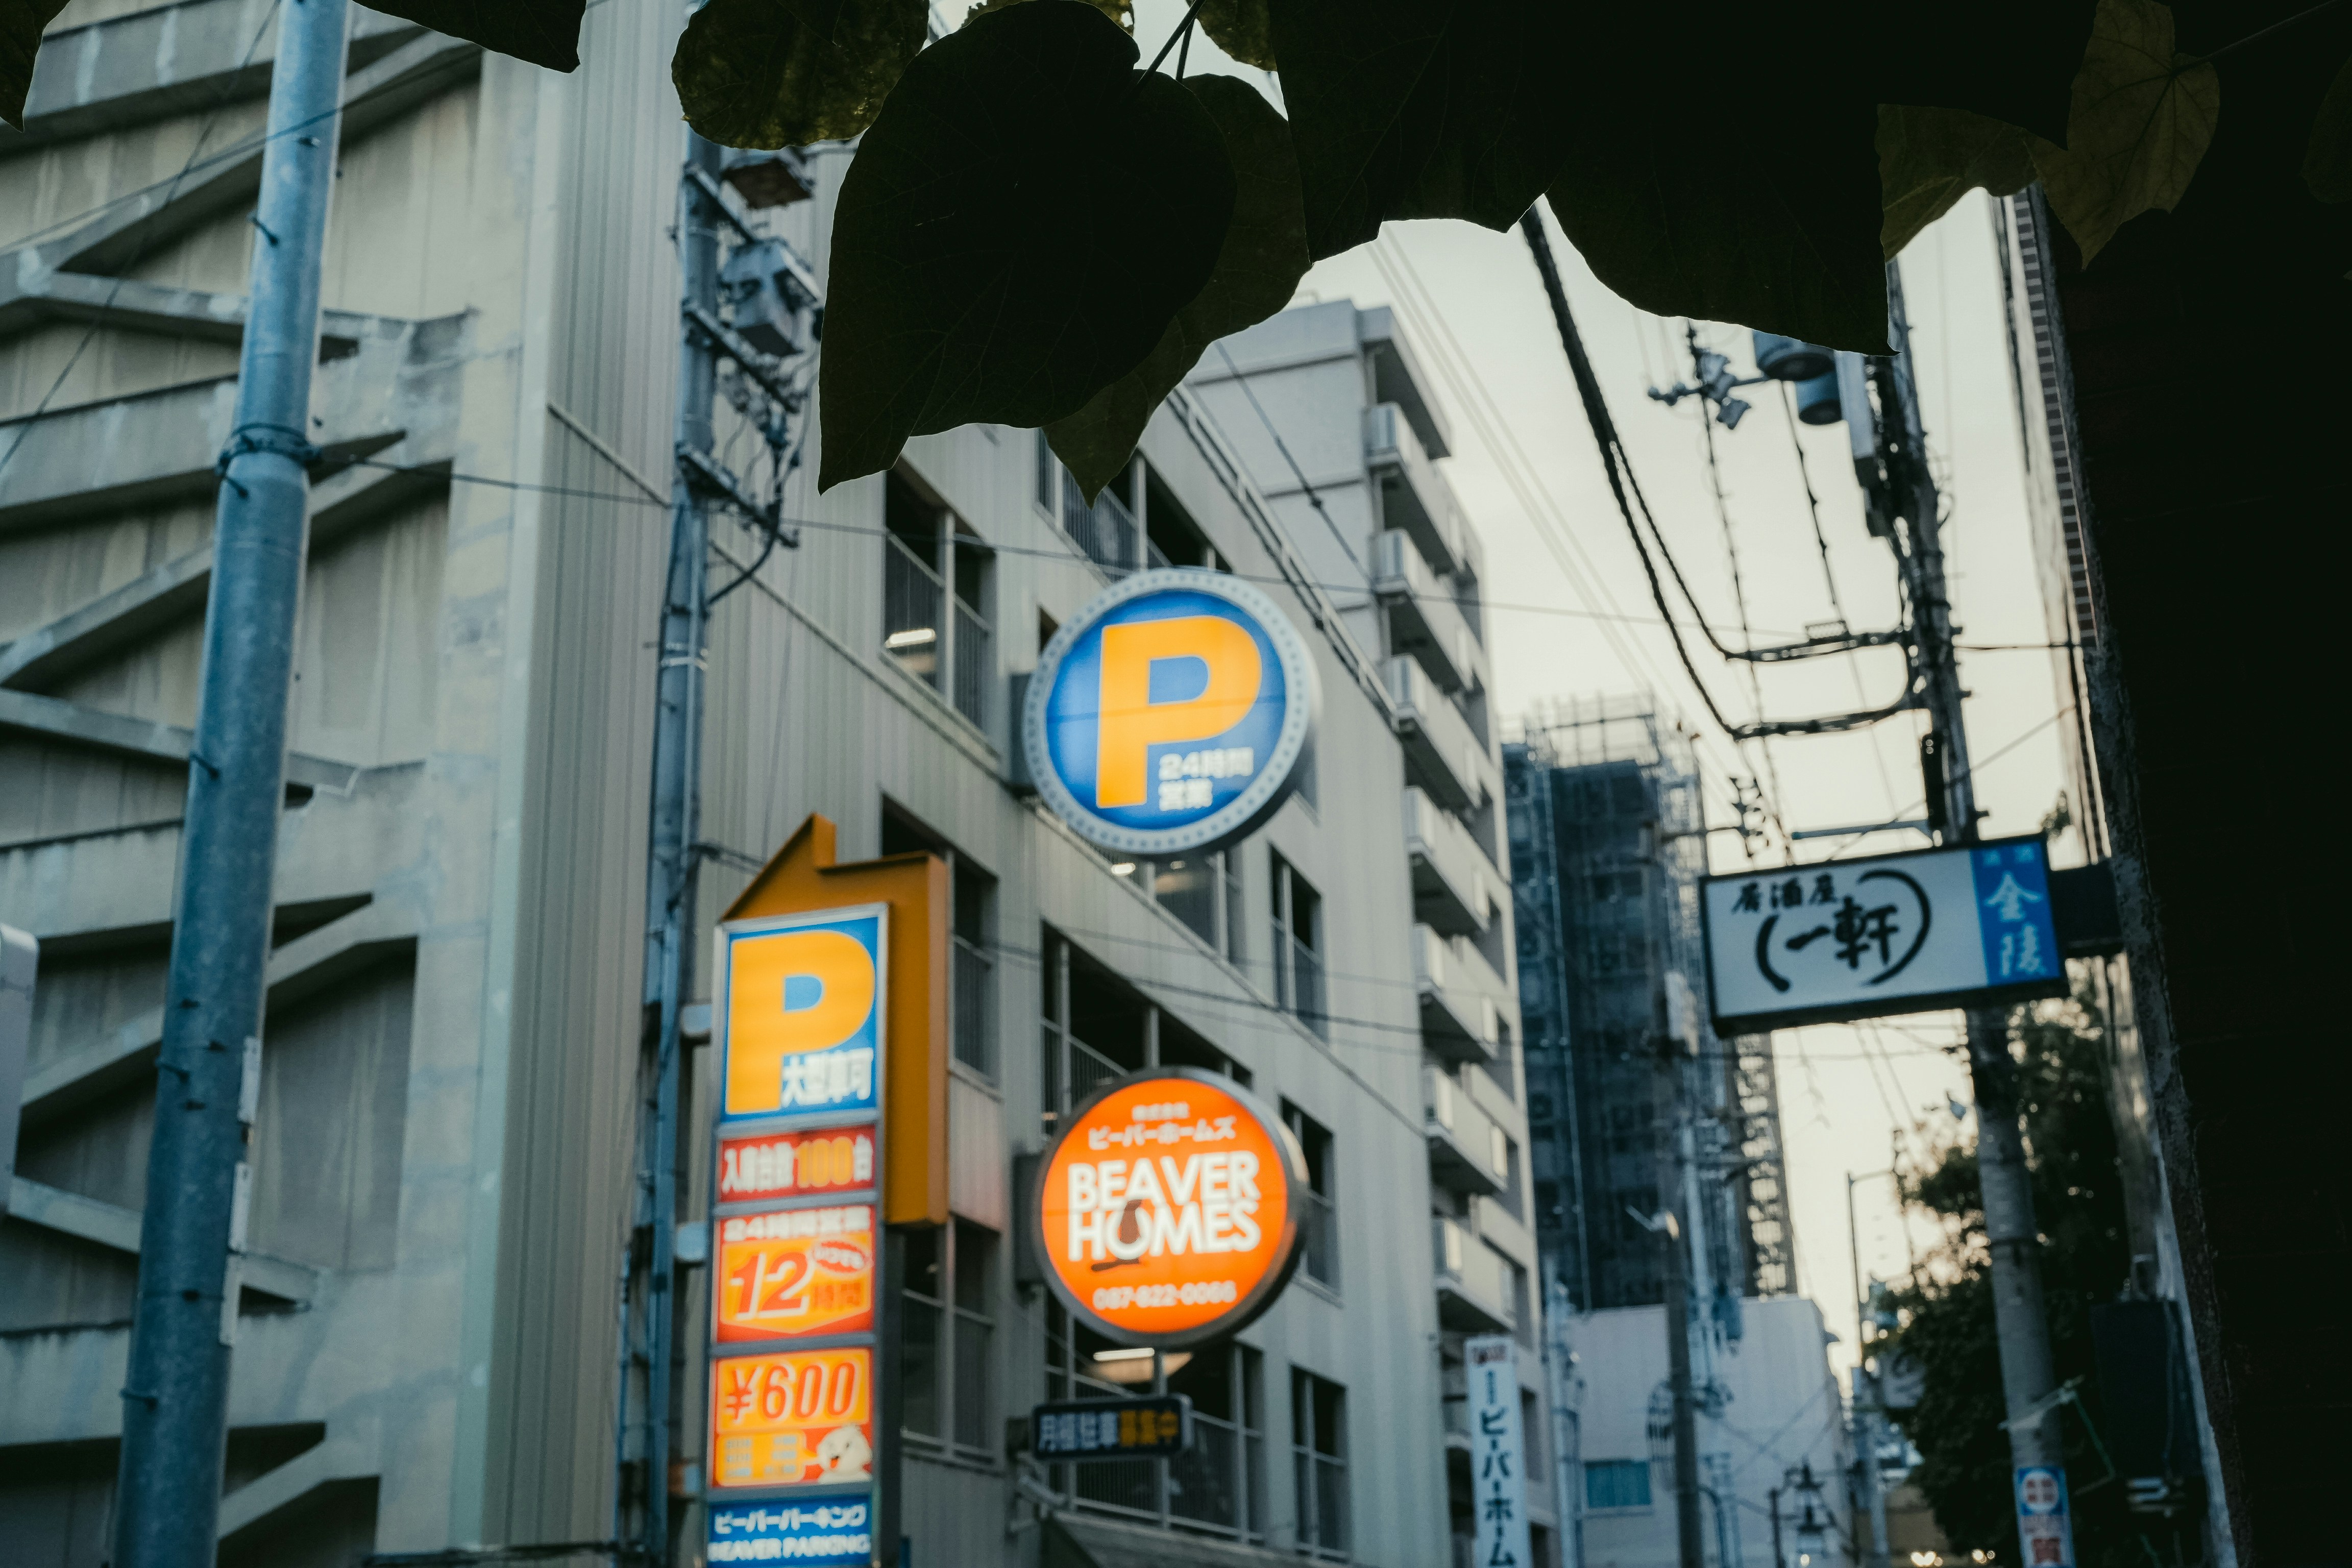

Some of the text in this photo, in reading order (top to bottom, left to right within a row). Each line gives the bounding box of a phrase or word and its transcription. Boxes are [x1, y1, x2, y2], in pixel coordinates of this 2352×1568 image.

[1096, 615, 1262, 808] P
[1732, 873, 1837, 914] 居酒屋
[725, 930, 875, 1115] P
[1088, 1115, 1237, 1150] ビーバーホームズ
[1067, 1149, 1261, 1213] BEAVER
[1067, 1198, 1262, 1262] HOMES
[726, 1360, 860, 1425] ¥600
[708, 1533, 871, 1561] BEAVER PARKING
